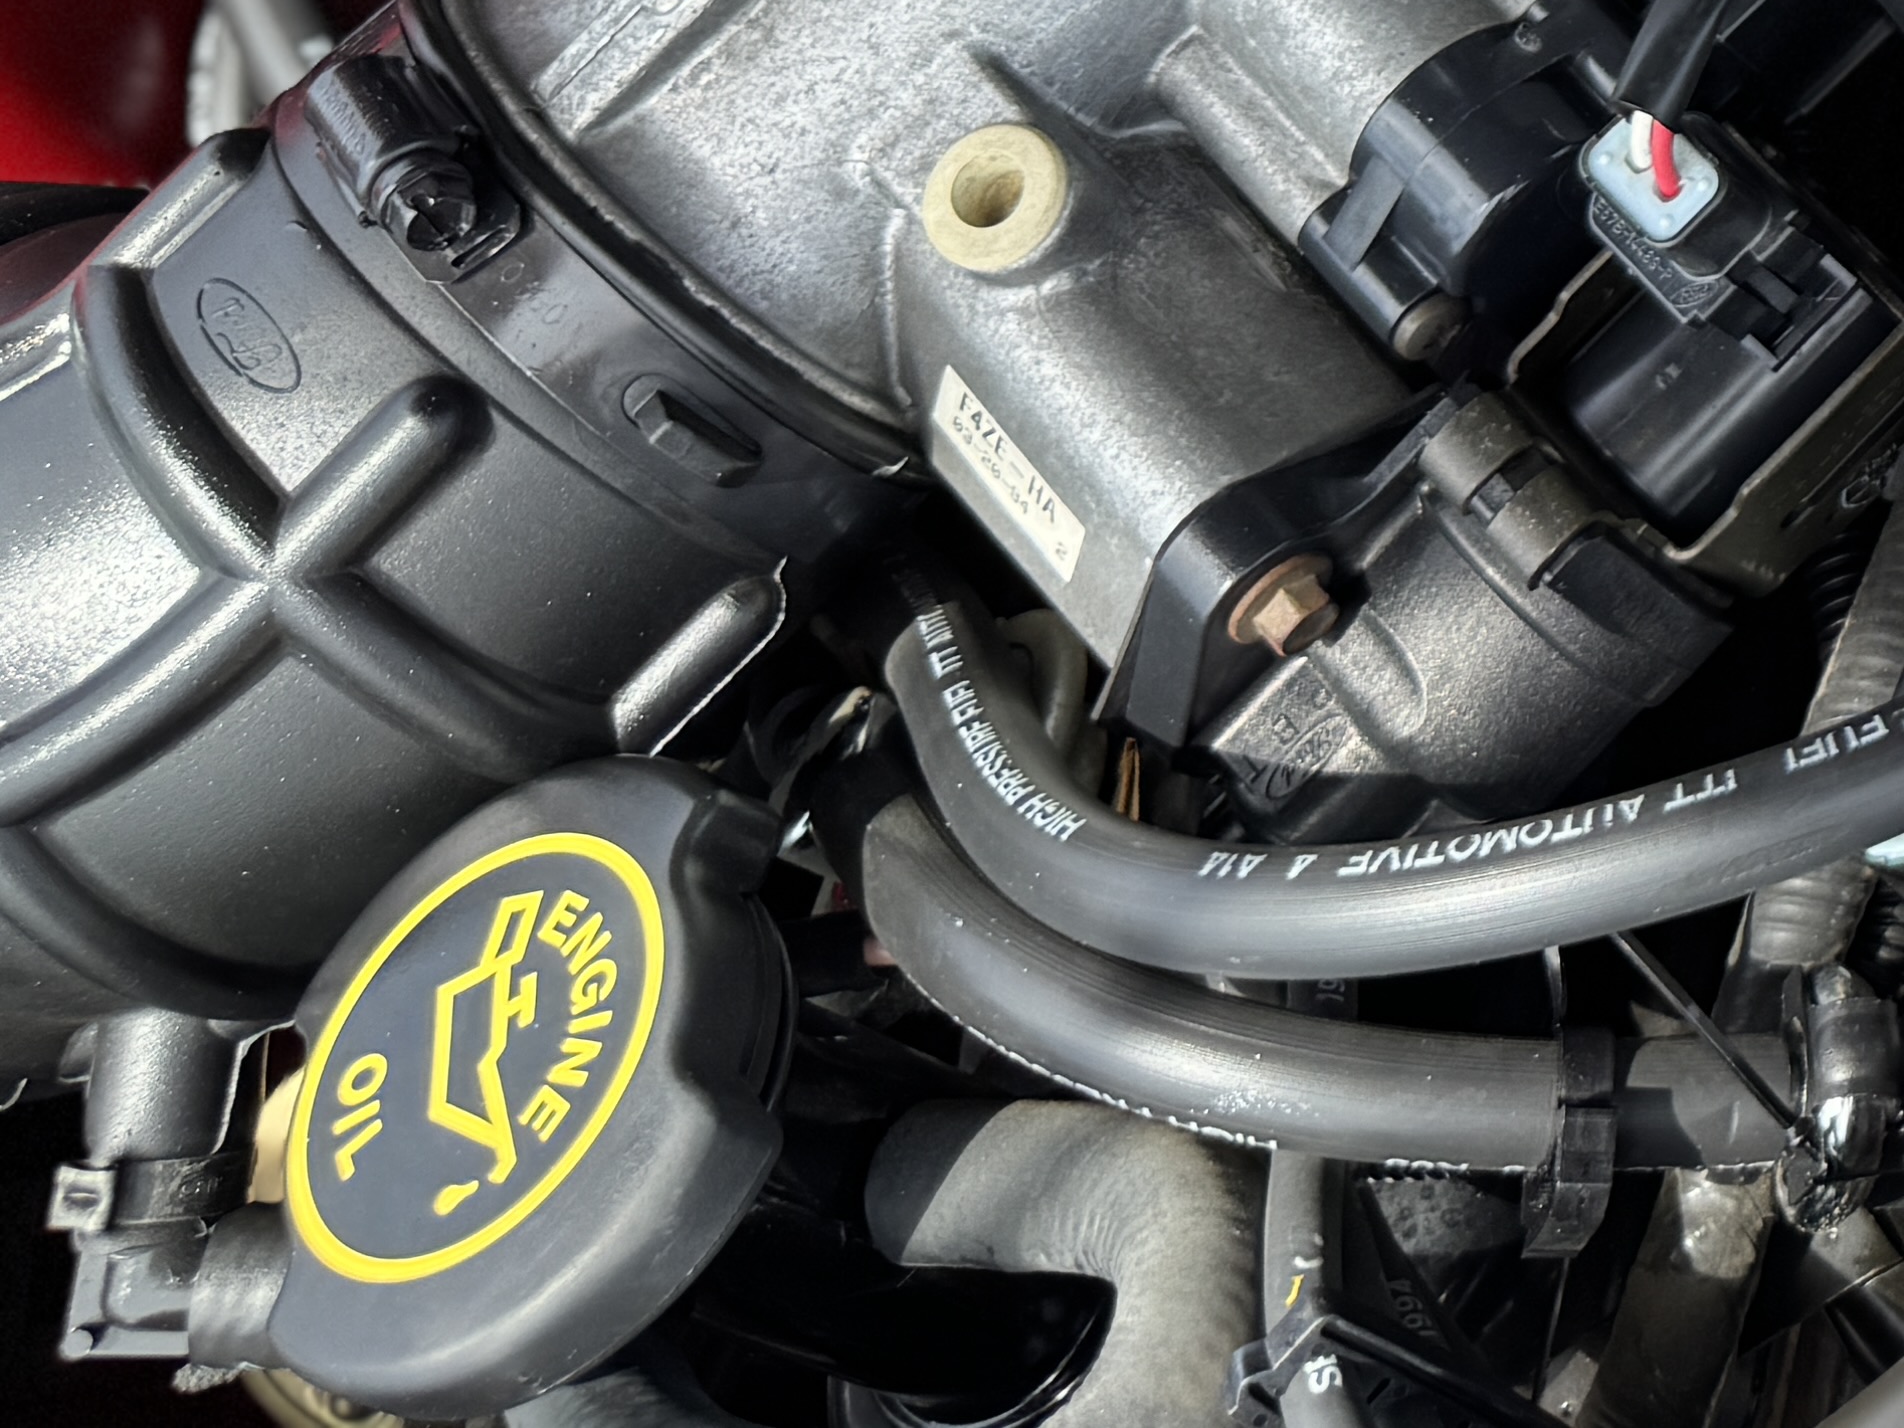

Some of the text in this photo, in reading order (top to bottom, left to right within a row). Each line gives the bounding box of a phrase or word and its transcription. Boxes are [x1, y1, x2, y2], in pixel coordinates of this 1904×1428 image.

[1337, 793, 1648, 878] AUTOMOTIVE
[1663, 766, 1739, 813] ITT
[521, 888, 618, 1142] ENGINE
[331, 1052, 390, 1182] OIL
